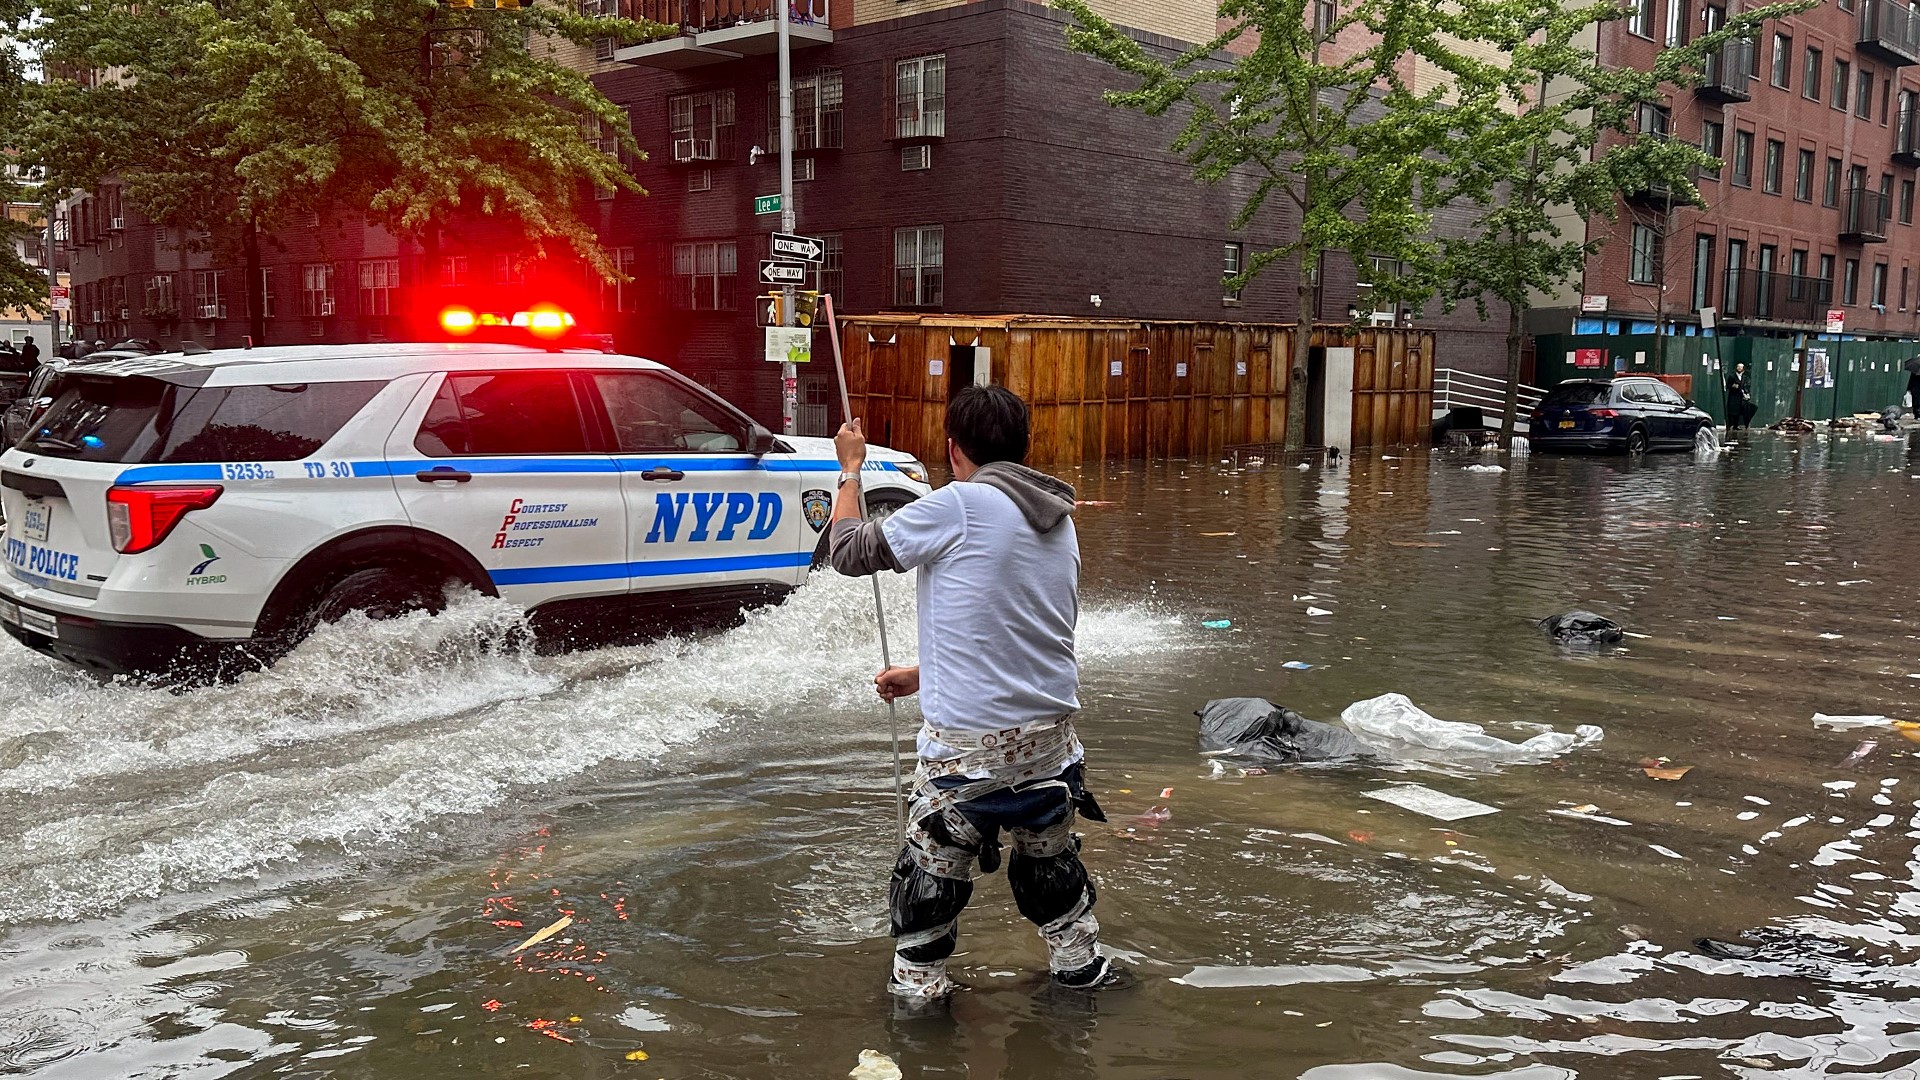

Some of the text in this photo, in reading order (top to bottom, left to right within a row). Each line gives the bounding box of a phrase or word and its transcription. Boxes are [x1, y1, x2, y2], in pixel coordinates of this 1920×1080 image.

[758, 199, 771, 212] Lee
[777, 241, 816, 254] ONE WAY
[768, 267, 801, 278] ONE WAY
[303, 461, 350, 478] TD 30
[644, 492, 783, 543] NYPD
[29, 546, 79, 580] POLICE
[186, 574, 227, 586] HYBRID
